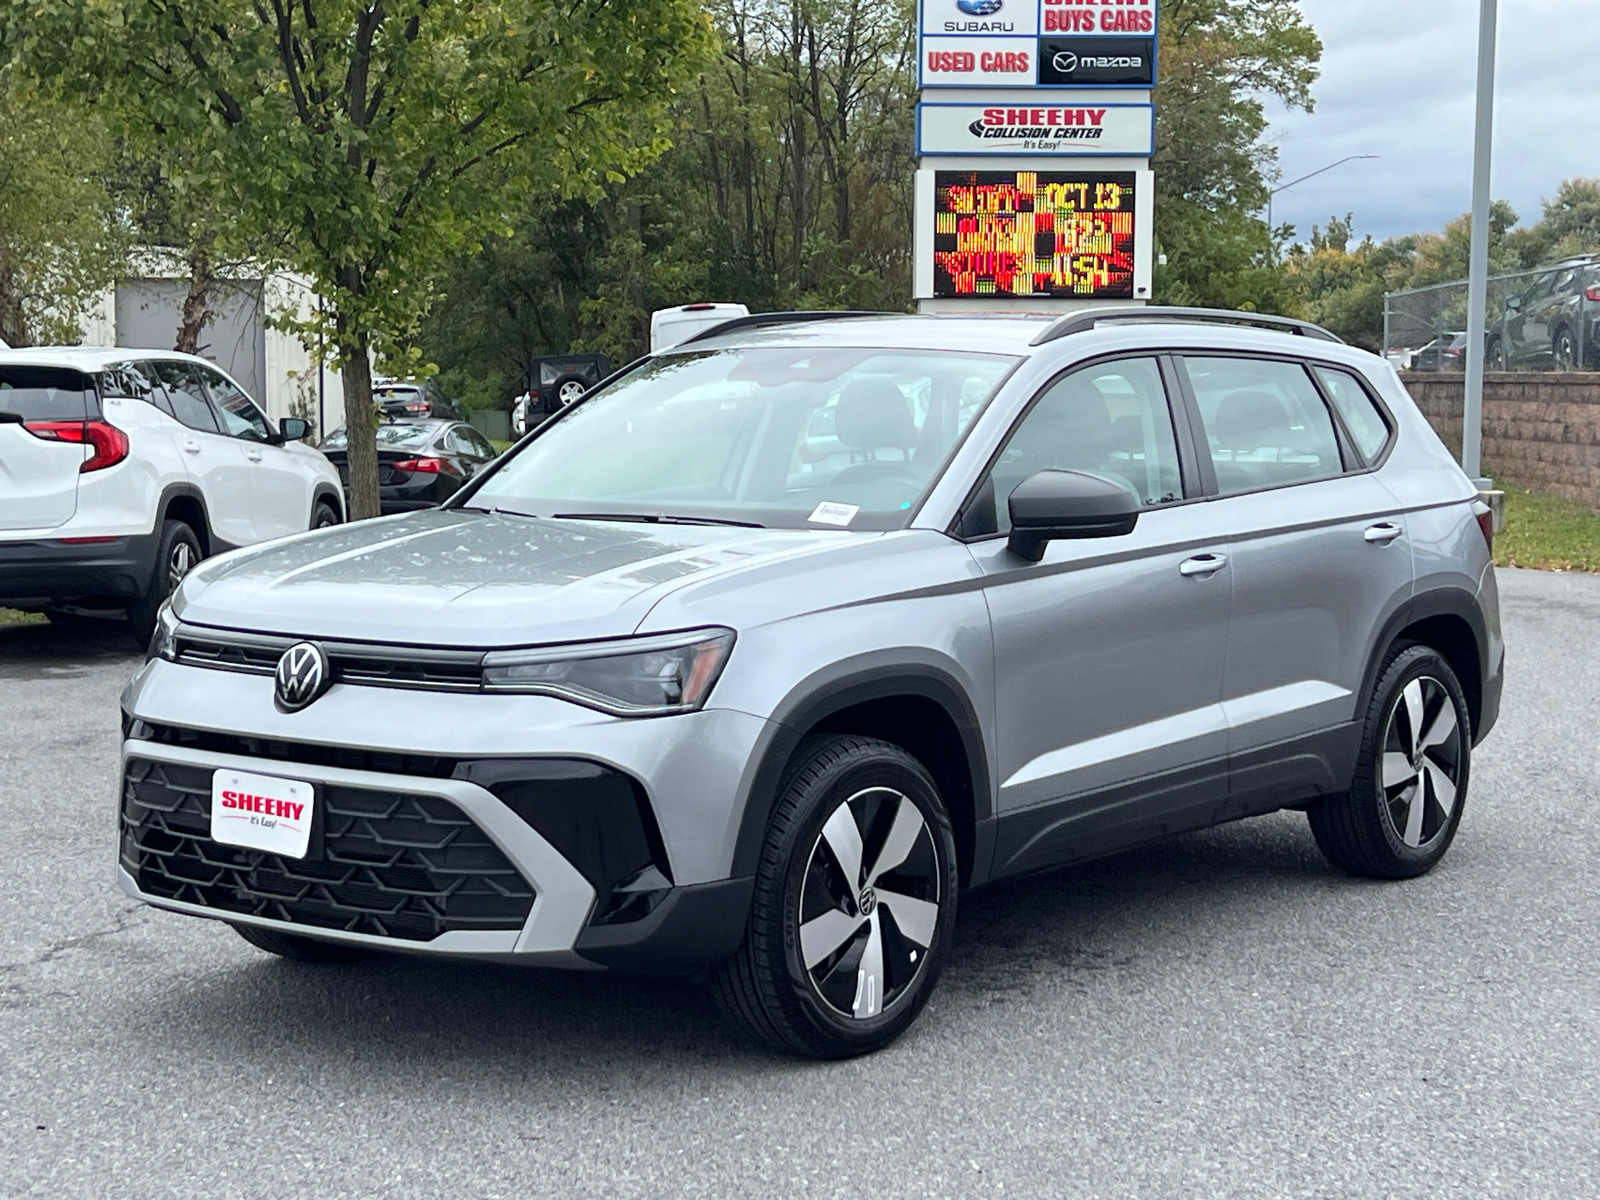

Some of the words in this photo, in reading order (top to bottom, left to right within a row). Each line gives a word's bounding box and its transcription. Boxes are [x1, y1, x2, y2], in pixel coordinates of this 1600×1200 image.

[944, 21, 1014, 32] SUBARU
[1045, 9, 1095, 32] BUYS
[1101, 10, 1152, 32] CARS
[928, 52, 975, 72] USED
[981, 52, 1029, 72] CARS
[1081, 56, 1142, 67] mazda
[983, 109, 1106, 125] SHEEHY
[984, 128, 1051, 139] COLLISION
[1053, 128, 1103, 138] CENTER
[1023, 140, 1036, 149] It's
[1038, 140, 1061, 151] Easy!
[1046, 183, 1088, 209] OCT
[1094, 183, 1120, 209] 13
[222, 790, 304, 821] SHEEHY
[250, 816, 260, 826] It's
[261, 817, 277, 830] Easy!
